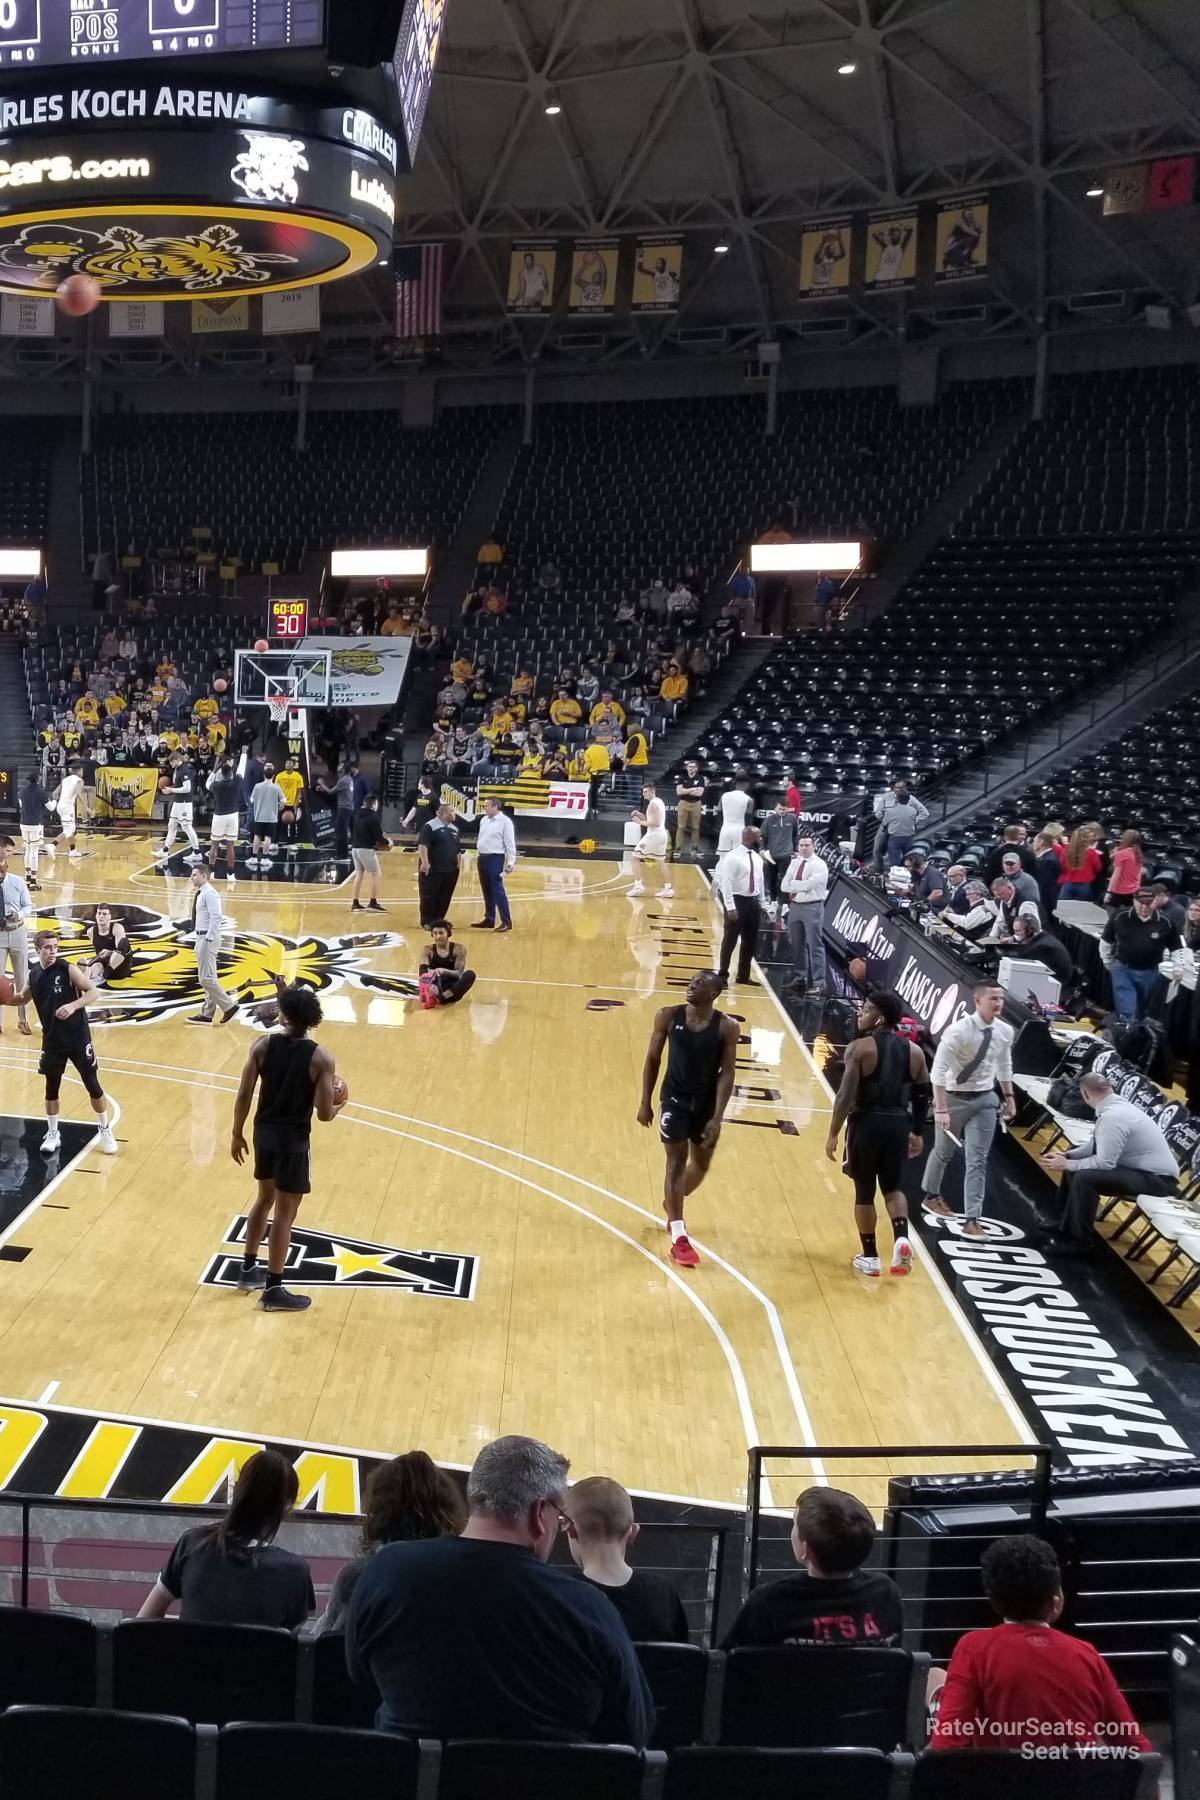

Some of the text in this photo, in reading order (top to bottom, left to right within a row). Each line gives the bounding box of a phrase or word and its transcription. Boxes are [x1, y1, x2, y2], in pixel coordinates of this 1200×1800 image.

[70, 13, 119, 43] POS
[71, 43, 119, 56] BONUS
[71, 88, 147, 120] KOCH
[154, 86, 252, 120] ARENA
[273, 603, 304, 615] 60:00
[276, 615, 300, 635] 30
[831, 898, 867, 943] KANSAS
[895, 954, 941, 1021] KANSAS
[864, 1612, 882, 1638] A
